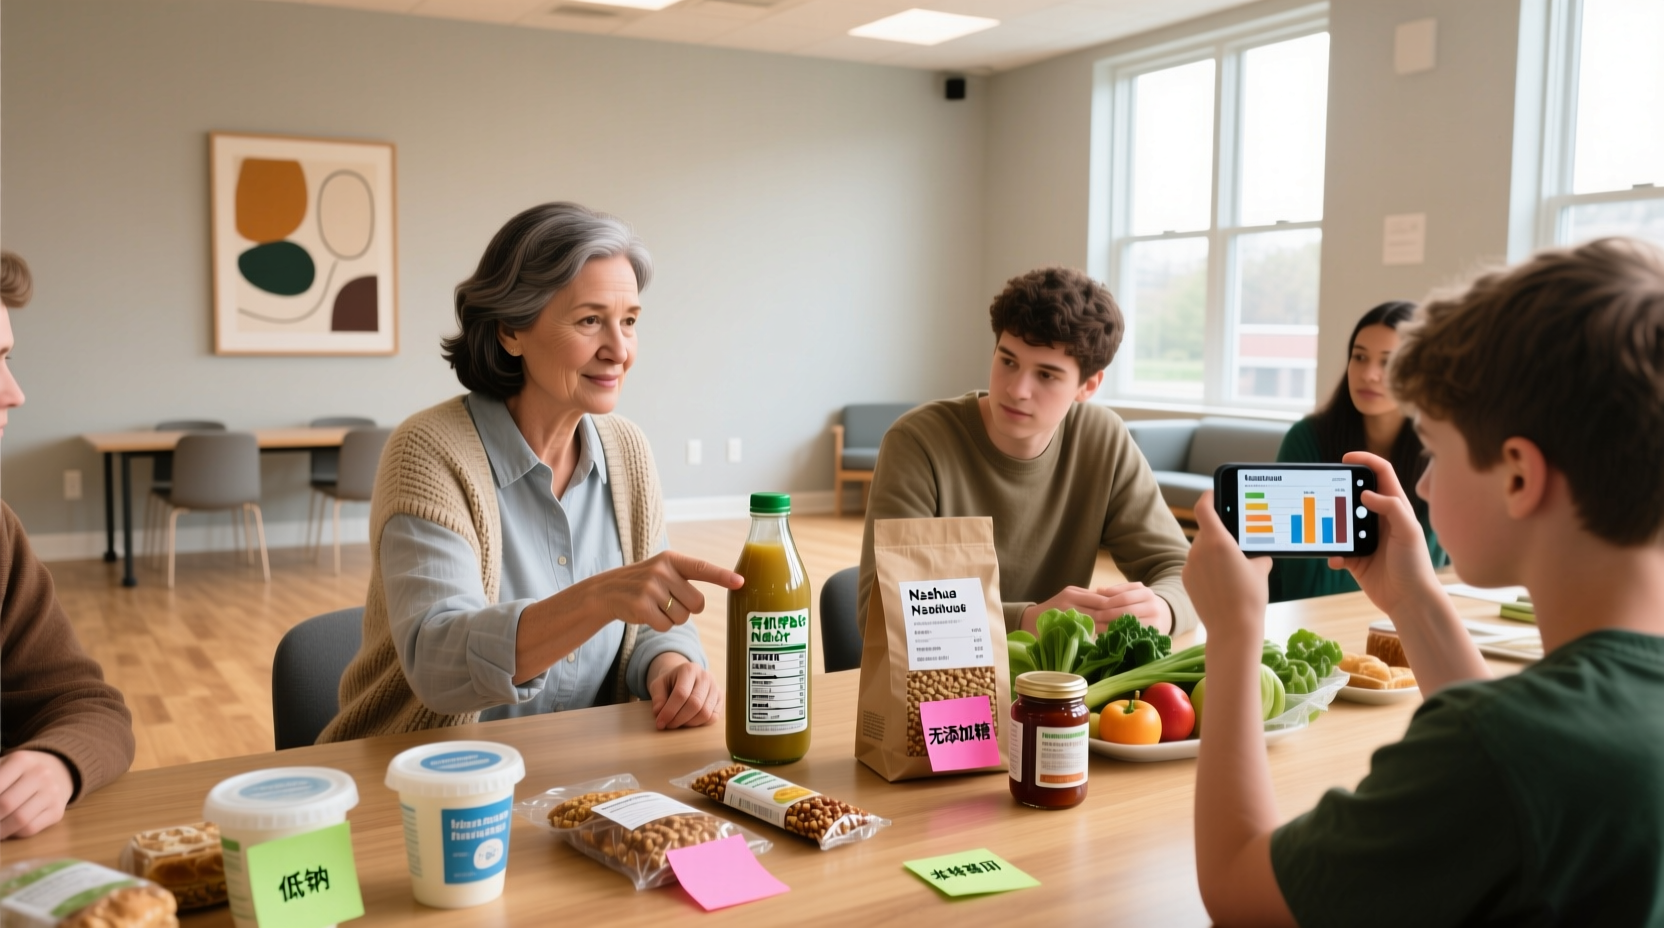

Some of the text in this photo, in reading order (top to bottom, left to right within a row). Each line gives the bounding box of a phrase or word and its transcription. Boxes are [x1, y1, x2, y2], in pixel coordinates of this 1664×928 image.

[928, 721, 991, 745] 无添加糖
[279, 865, 330, 902] 低钠
